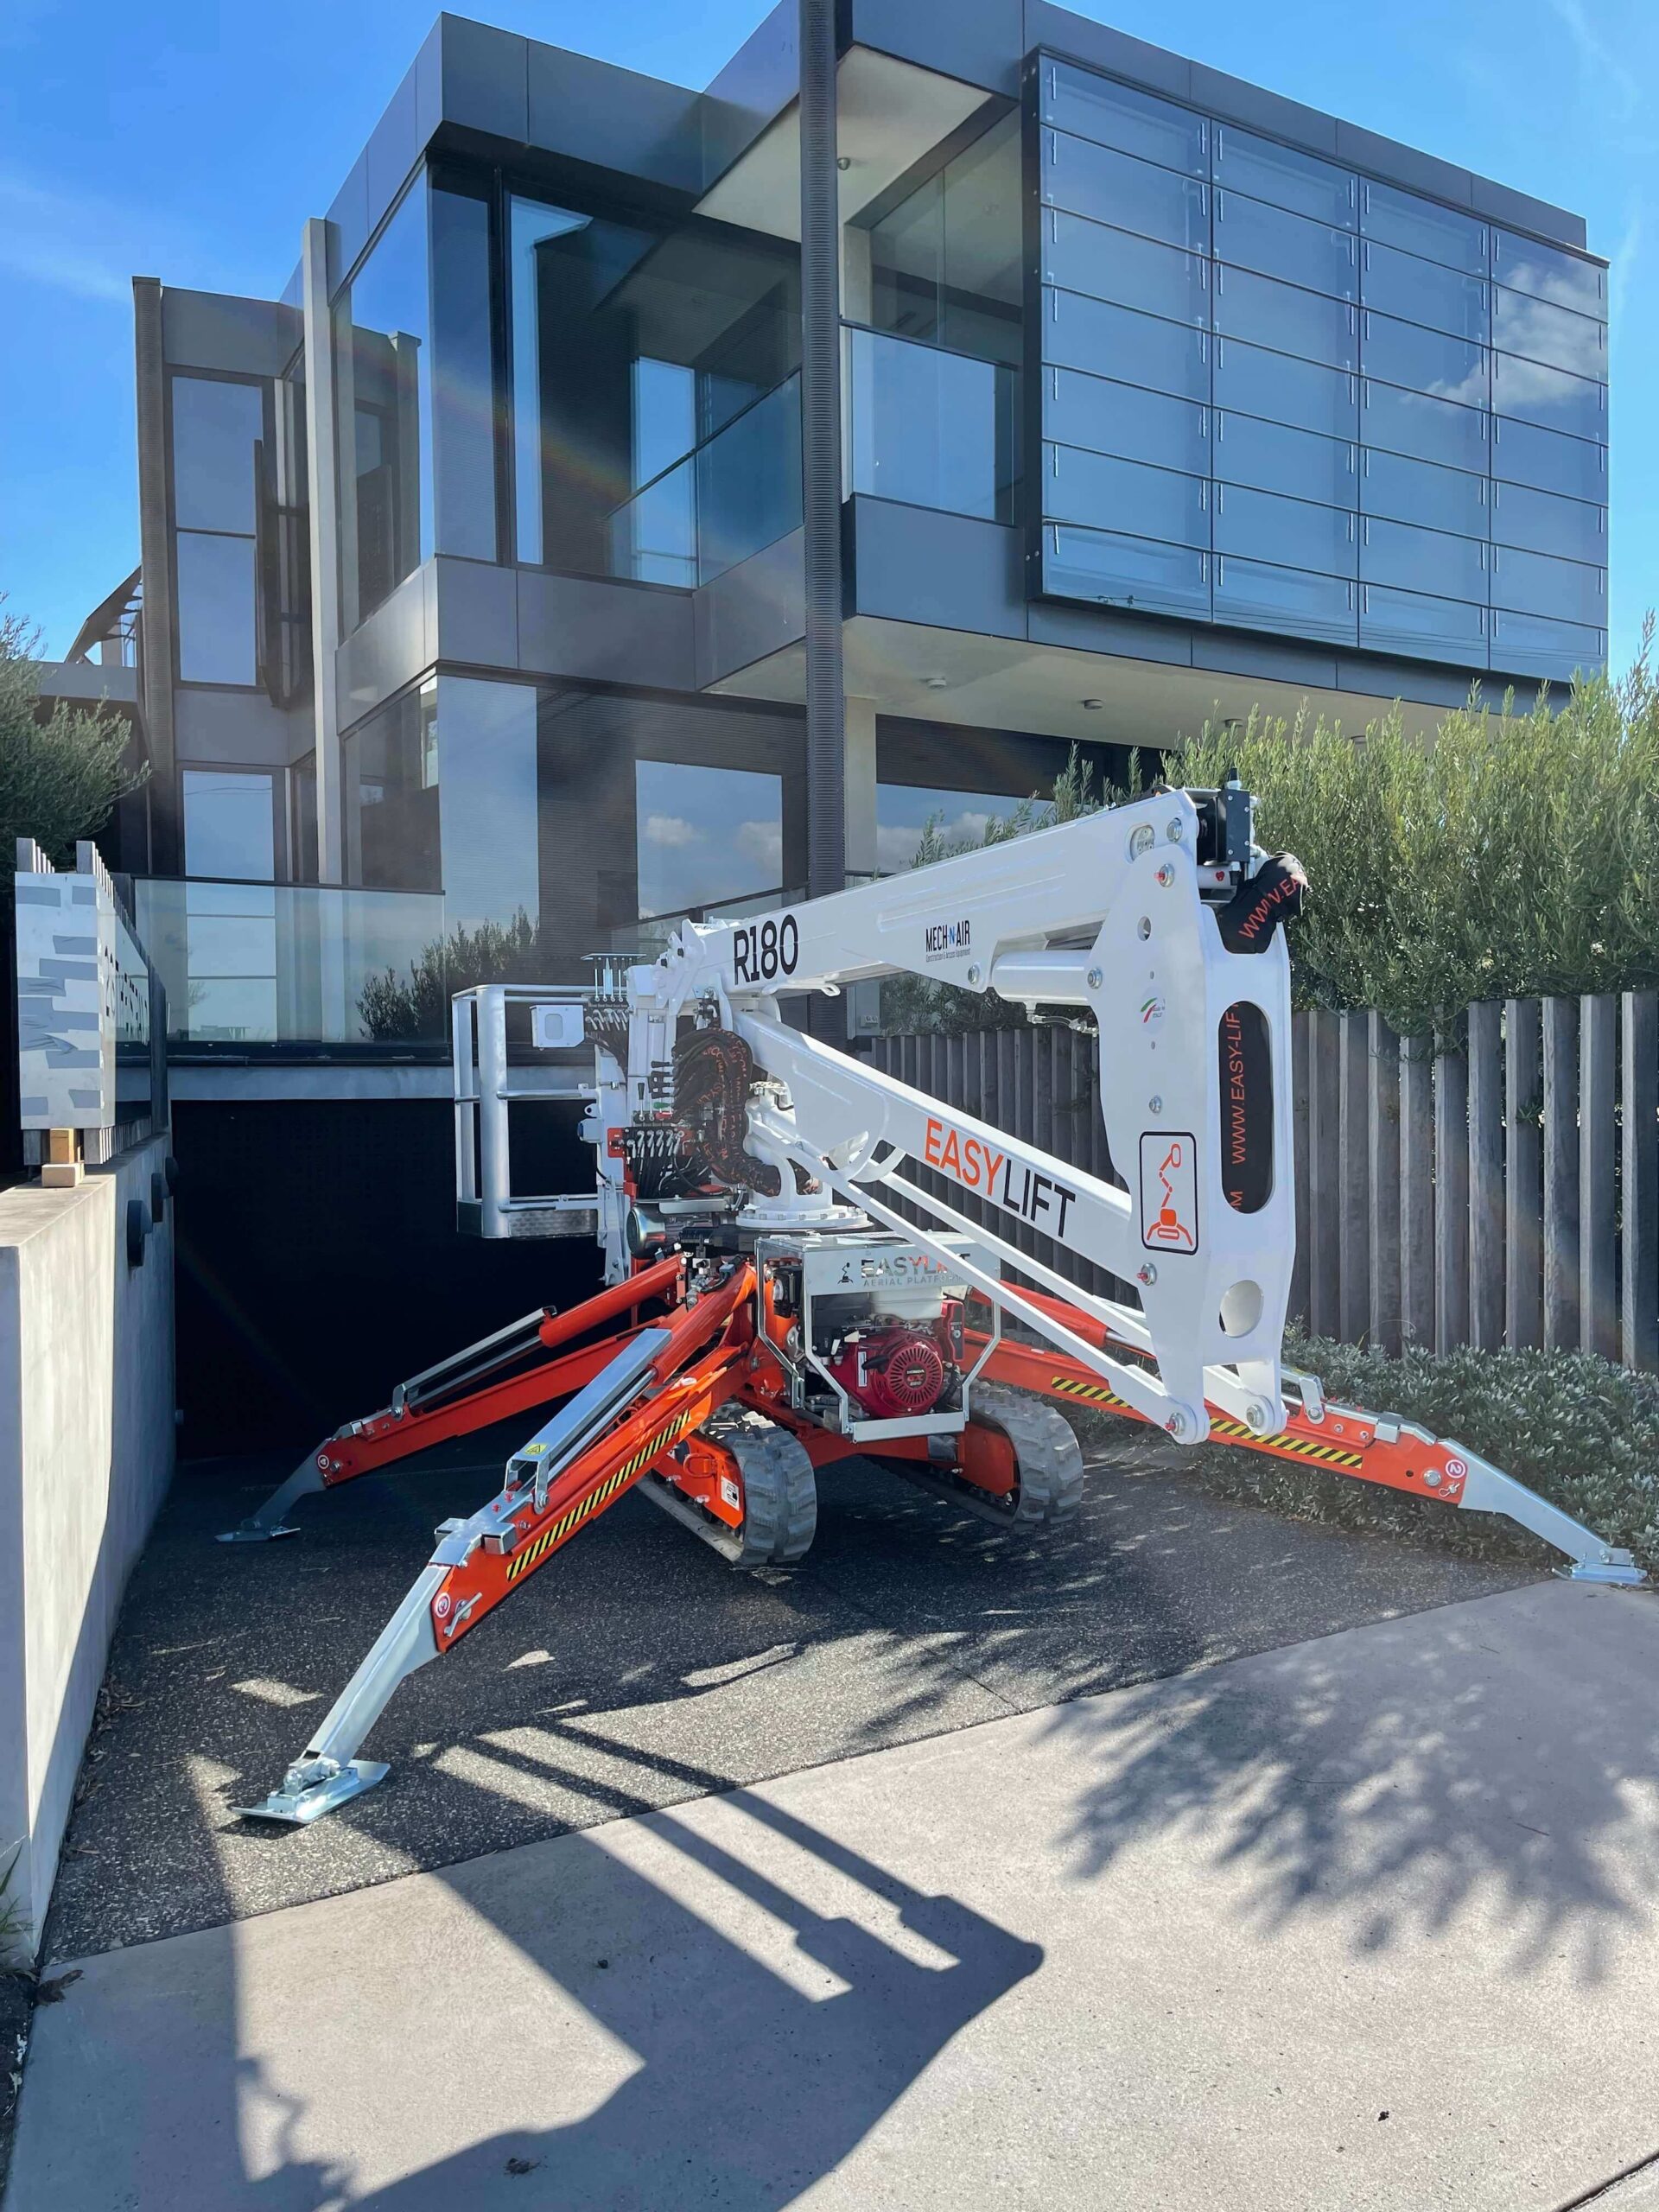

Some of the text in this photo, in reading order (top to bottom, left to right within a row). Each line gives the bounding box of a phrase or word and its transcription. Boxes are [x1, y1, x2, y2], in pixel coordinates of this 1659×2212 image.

[734, 914, 798, 985] R180
[1225, 1003, 1246, 1165] WWW.EASY-LIF
[925, 1117, 1076, 1238] EASYLIFT
[863, 1277, 903, 1287] AERIAL
[1450, 1463, 1462, 1474] 2
